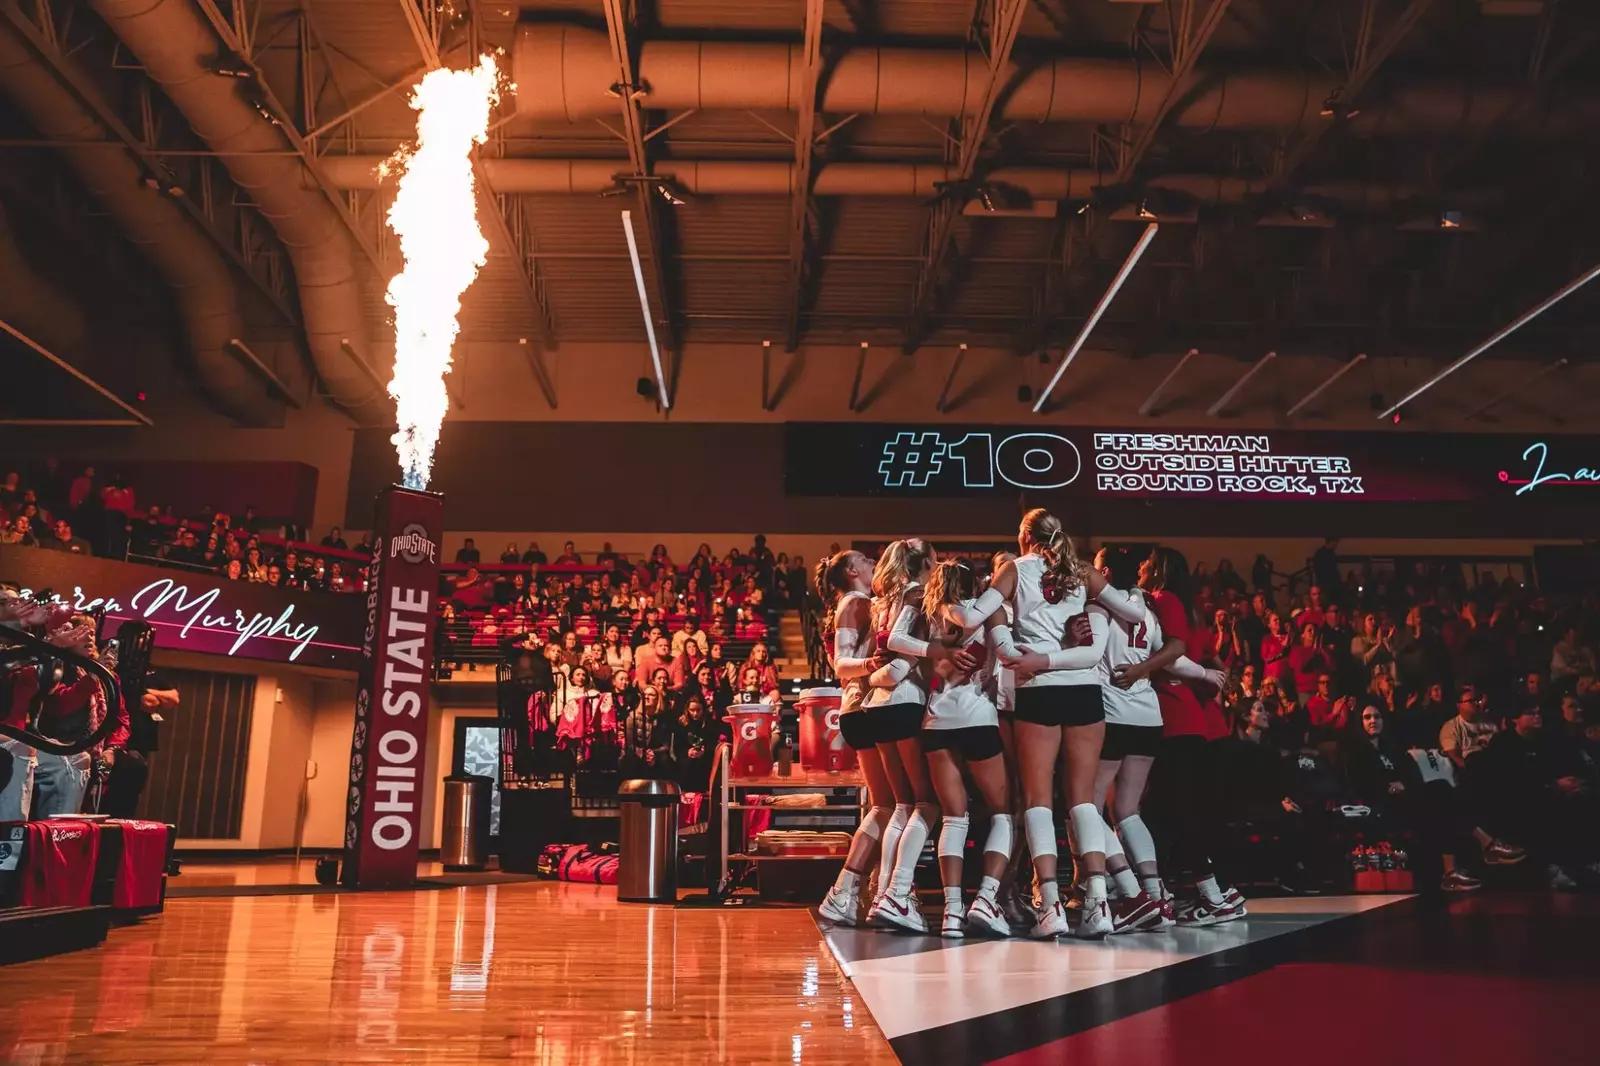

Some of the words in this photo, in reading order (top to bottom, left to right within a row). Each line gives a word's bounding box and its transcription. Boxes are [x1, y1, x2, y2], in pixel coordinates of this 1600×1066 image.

[1094, 433, 1270, 453] FRESHMAN
[878, 432, 1081, 489] #10
[1095, 453, 1236, 472] OUTSIDE
[1240, 456, 1352, 474] HITTER
[1097, 473, 1214, 492] ROUND
[1217, 475, 1317, 496] ROCK,
[1319, 476, 1365, 494] TX
[131, 578, 319, 661] Murphy
[1127, 619, 1148, 650] 12
[382, 586, 429, 719] STATE
[741, 722, 757, 740] G
[372, 730, 418, 850] OHIO
